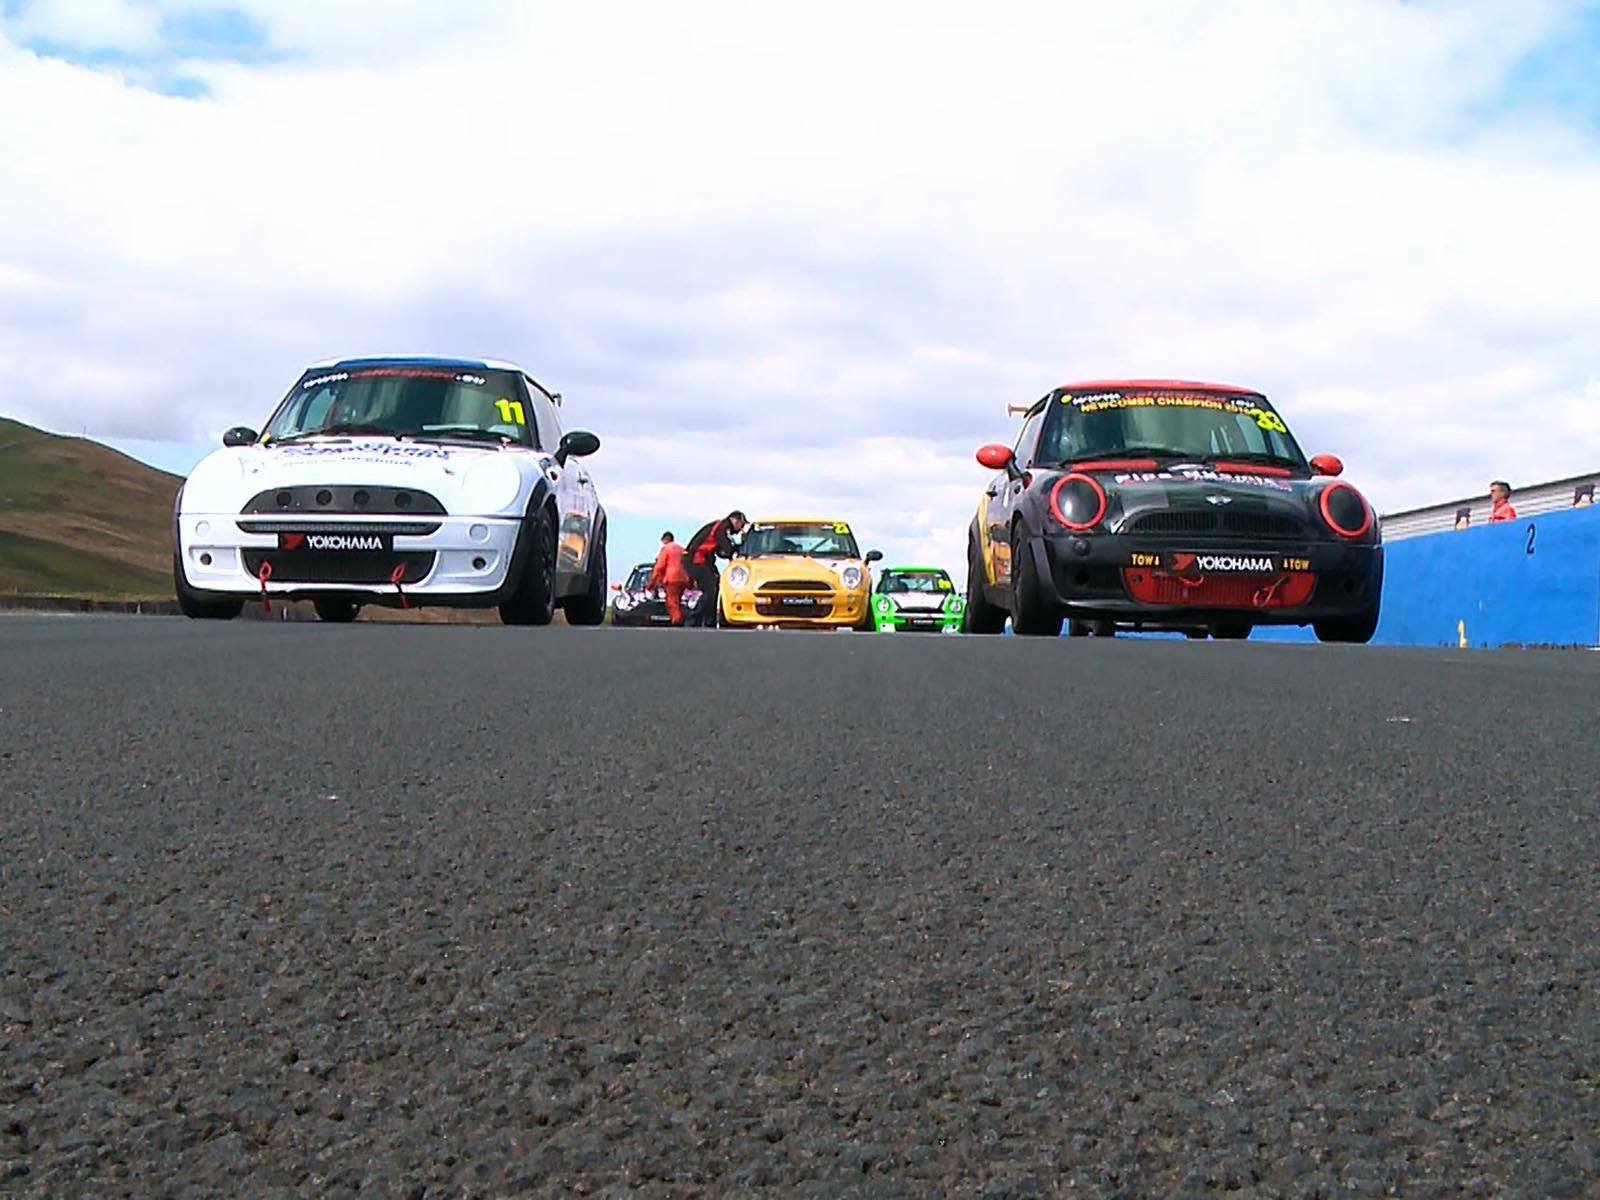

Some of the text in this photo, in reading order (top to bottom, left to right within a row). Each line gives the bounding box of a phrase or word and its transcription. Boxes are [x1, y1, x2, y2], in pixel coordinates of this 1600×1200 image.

[1157, 397, 1223, 410] CHAMPION
[494, 398, 526, 425] 11
[306, 535, 383, 550] YOKOHAMA
[1526, 523, 1536, 554] 2
[1131, 553, 1152, 566] TOW
[1196, 556, 1273, 571] YOKOHAMA
[1289, 558, 1310, 570] TOW
